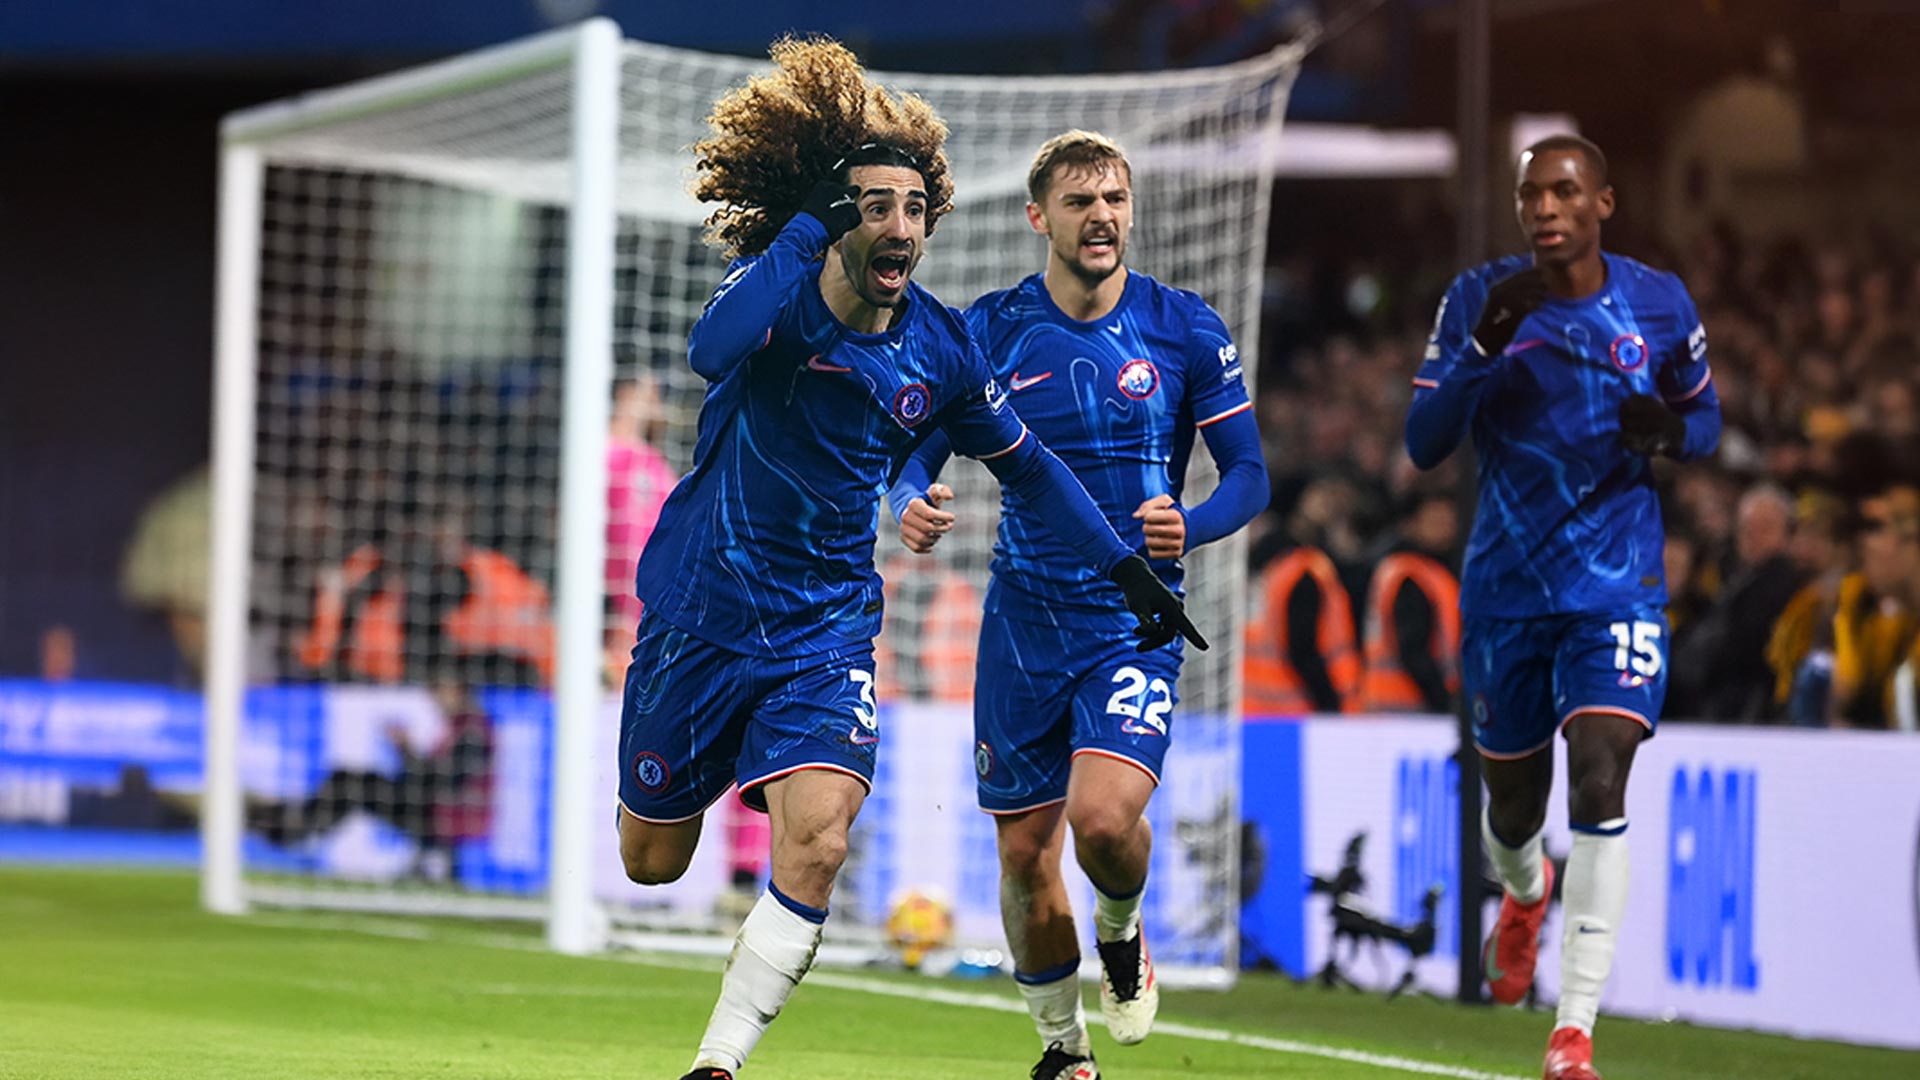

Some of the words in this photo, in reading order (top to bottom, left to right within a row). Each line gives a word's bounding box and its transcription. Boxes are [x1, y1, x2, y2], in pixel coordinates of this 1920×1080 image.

[1609, 620, 1662, 677] 15
[849, 668, 878, 731] 3
[1106, 666, 1172, 736] 22
